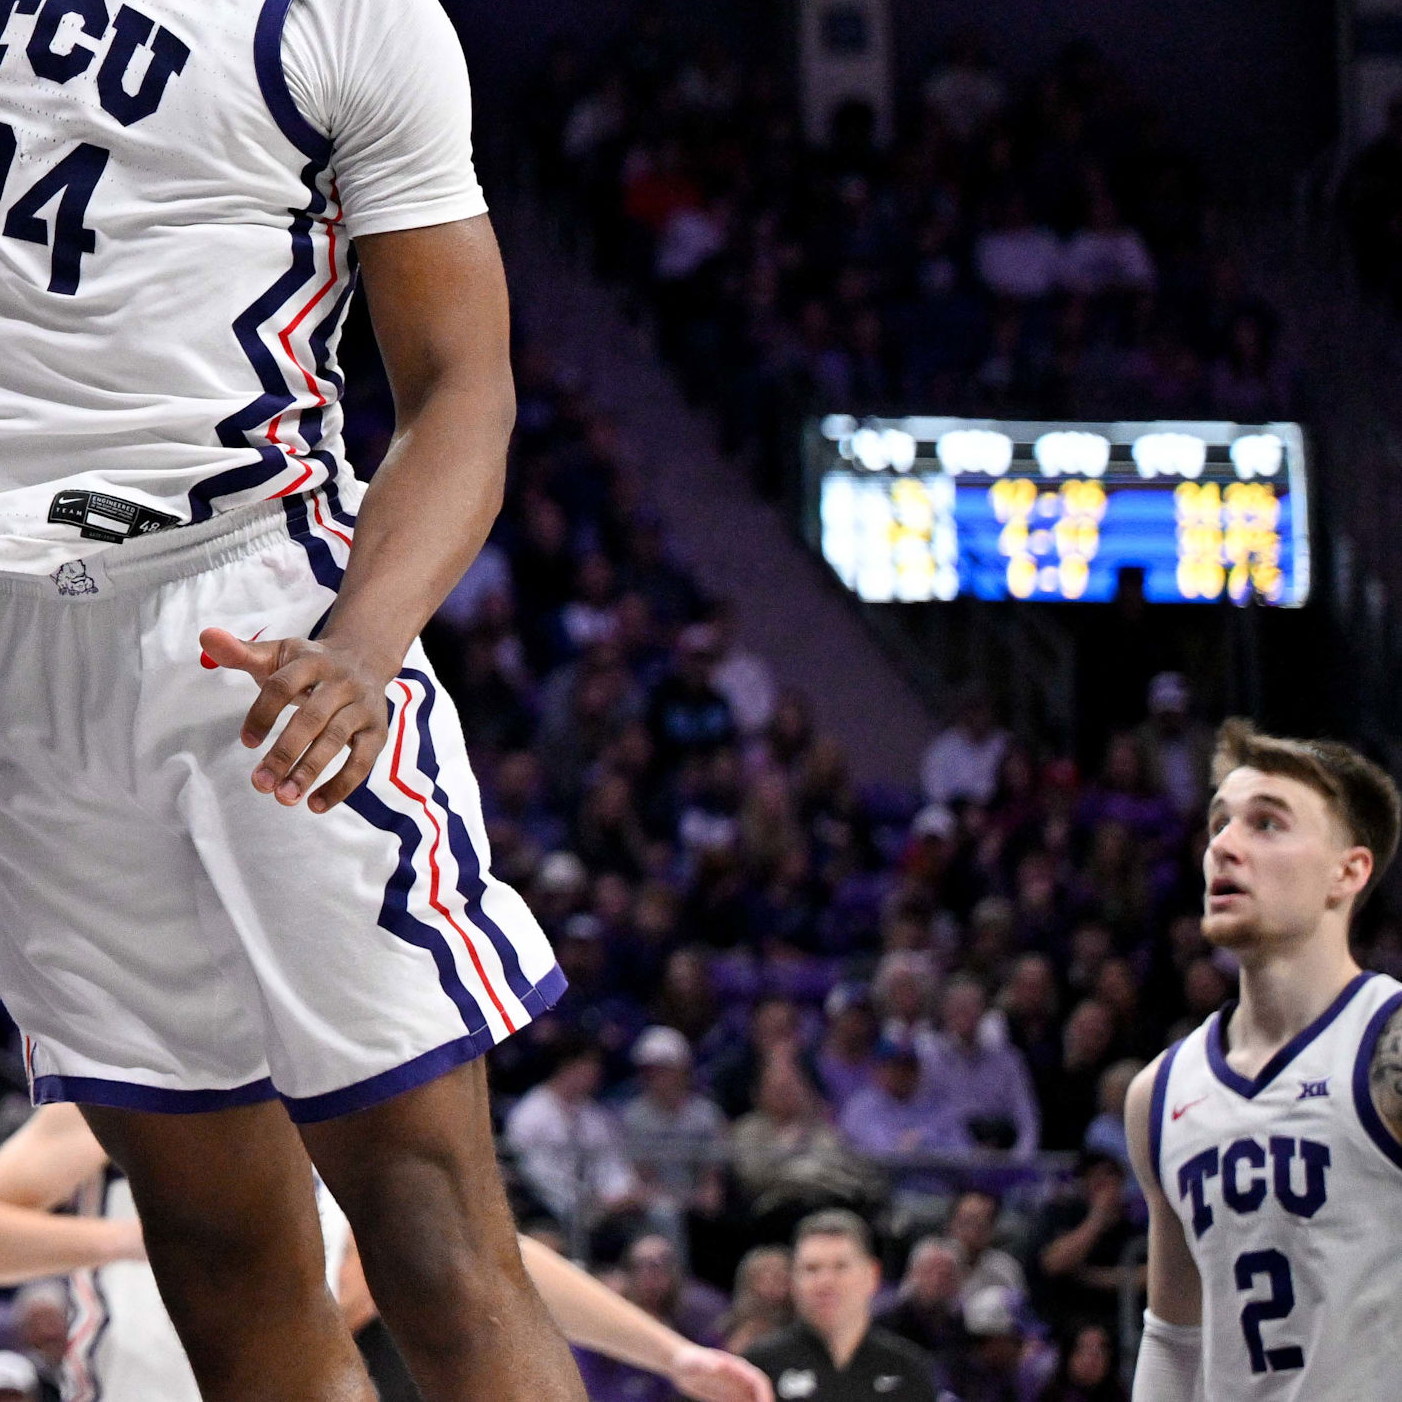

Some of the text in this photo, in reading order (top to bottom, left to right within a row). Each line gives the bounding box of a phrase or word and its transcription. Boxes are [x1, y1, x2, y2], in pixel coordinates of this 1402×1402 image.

[56, 507, 82, 516] TEAM
[92, 496, 135, 513] ENGINEERED
[1177, 1134, 1332, 1242] TCU
[1233, 1247, 1305, 1375] 2
